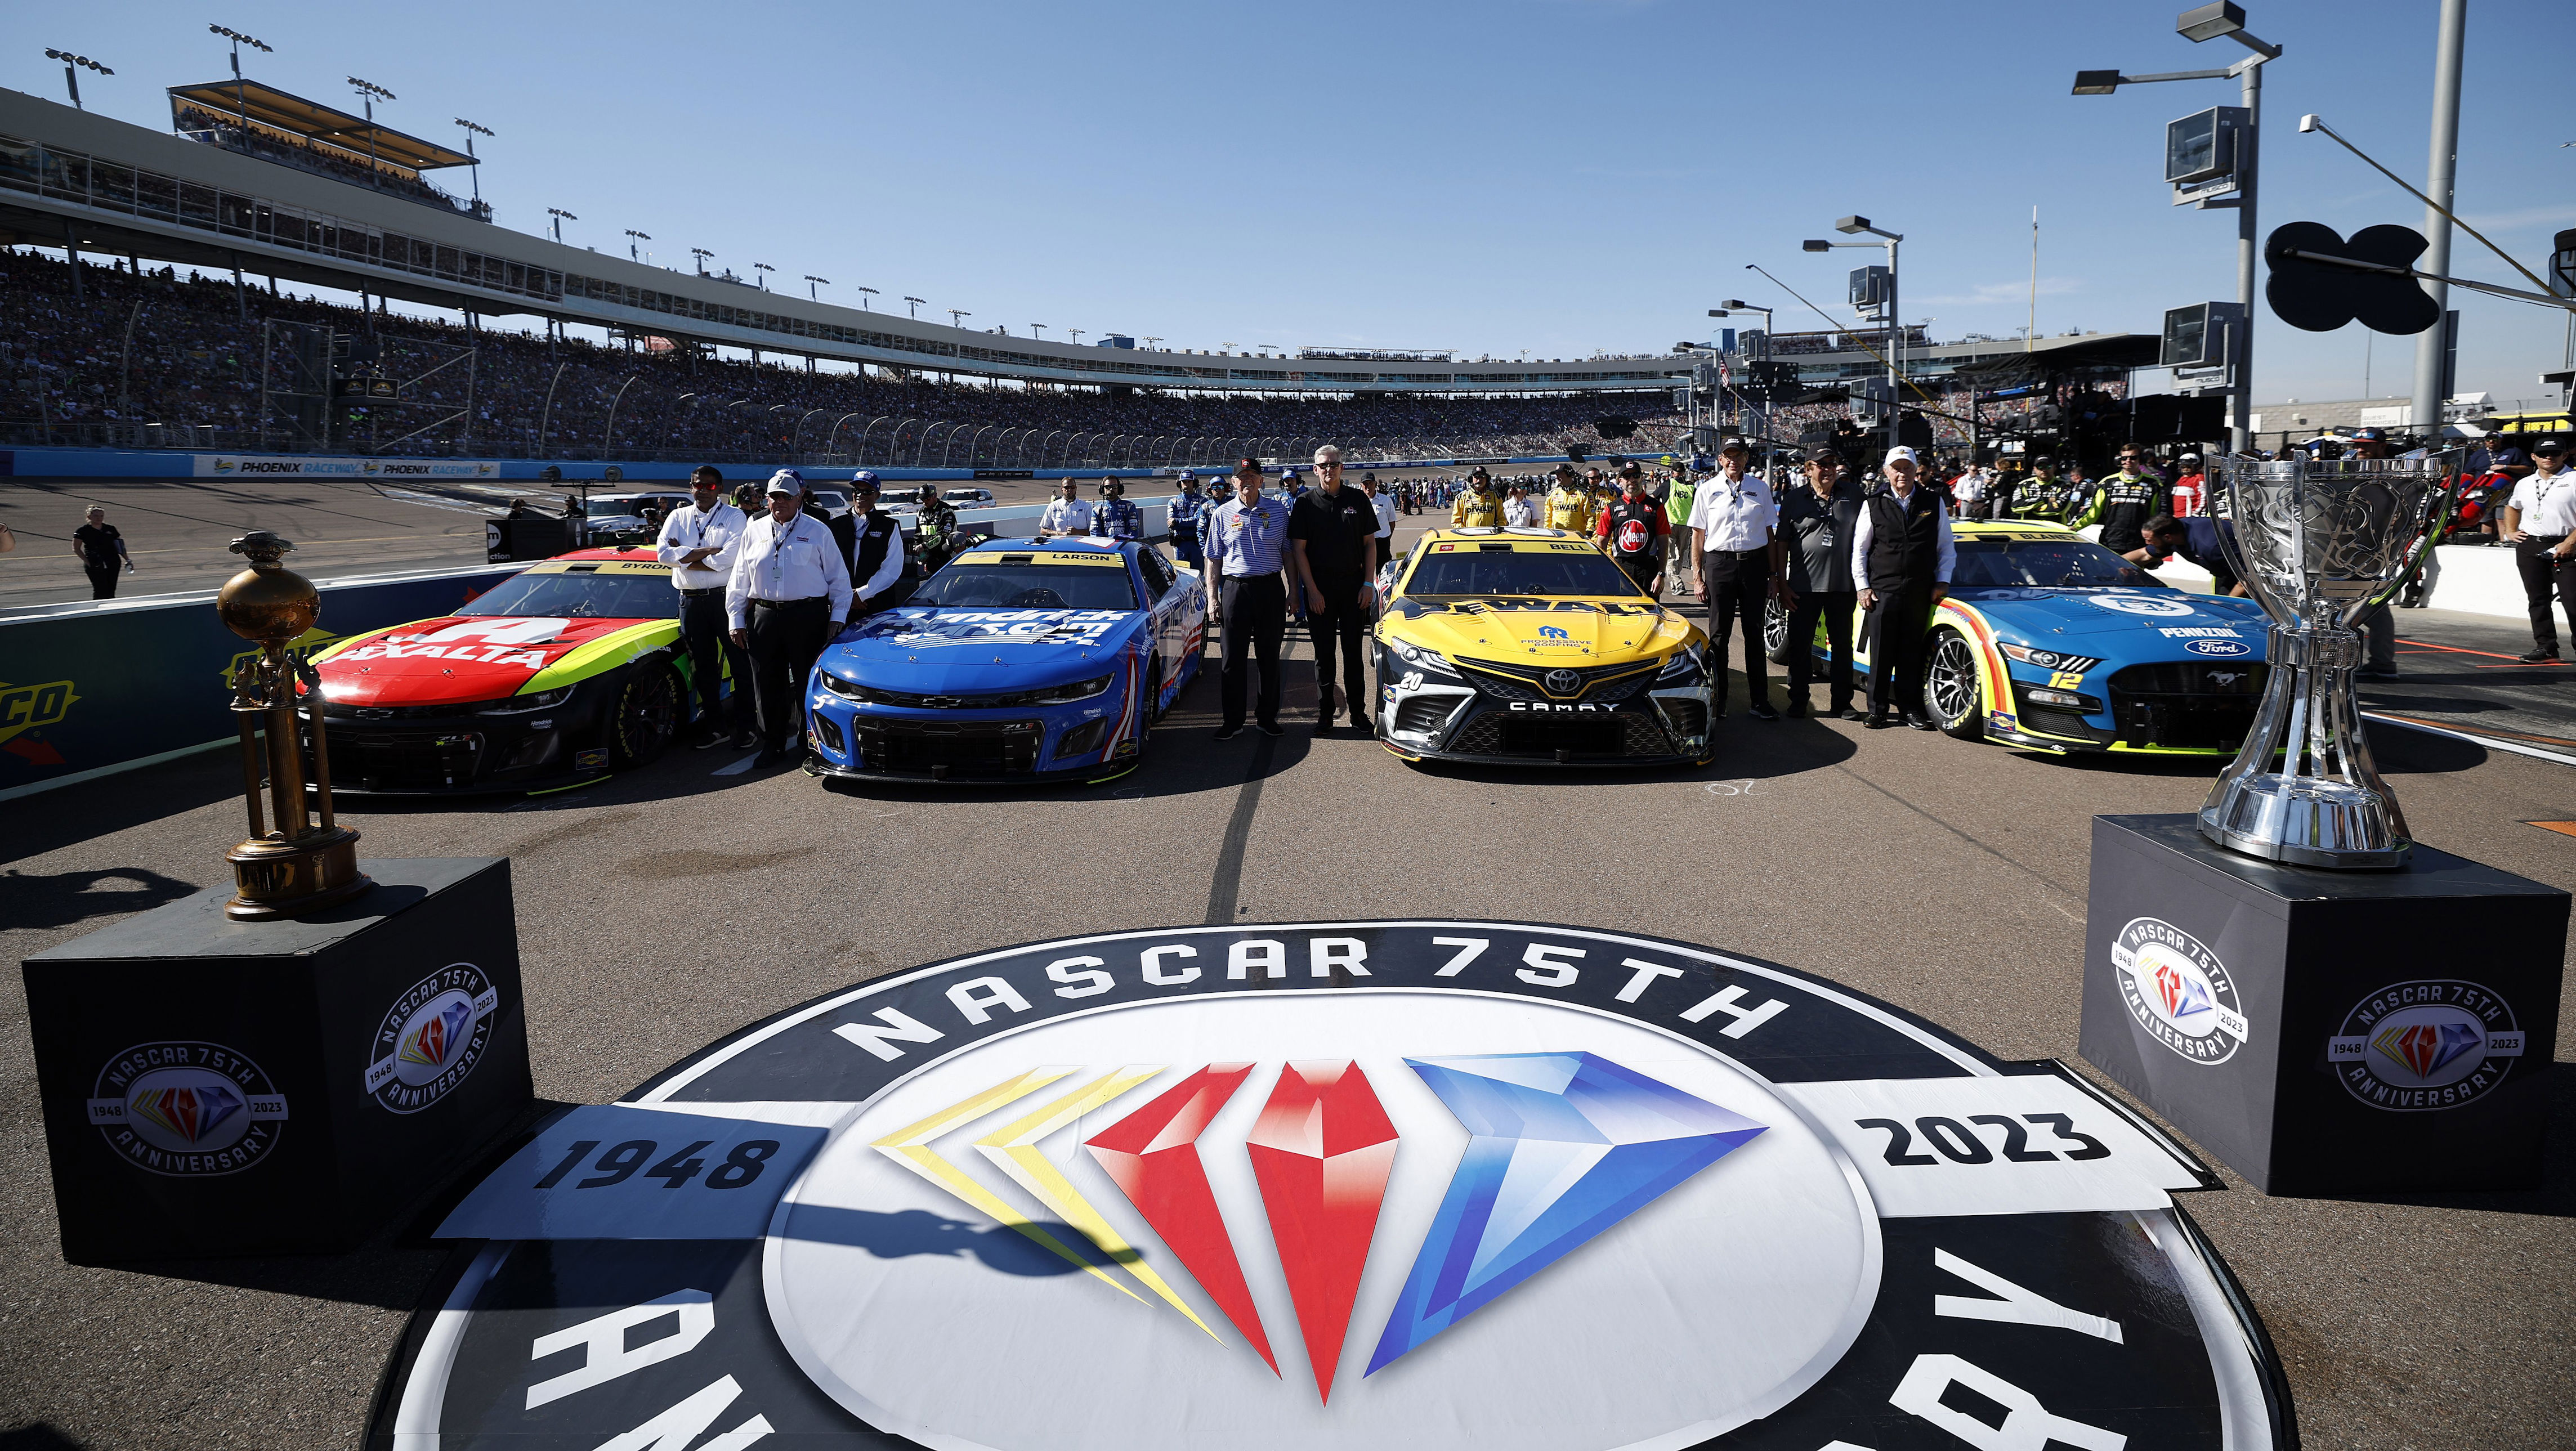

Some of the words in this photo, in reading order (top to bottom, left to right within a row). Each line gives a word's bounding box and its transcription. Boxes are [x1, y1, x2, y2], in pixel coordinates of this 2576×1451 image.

[240, 462, 302, 473] PHOENIX
[303, 463, 358, 473] RACEWAY
[384, 465, 431, 474] PHOENIX
[432, 465, 473, 474] RACEWAY
[1675, 490, 1689, 499] NBC
[1621, 527, 1646, 547] Rheem
[2158, 628, 2243, 638] PENNZOIL
[2199, 642, 2239, 653] Ford
[1399, 671, 1424, 691] 20
[2047, 671, 2083, 690] 12
[1991, 716, 2015, 727] SUNOCO
[1116, 744, 1136, 753] SUNOCO
[578, 755, 606, 764] SUNOCO
[2115, 950, 2132, 967] 1948
[2129, 924, 2185, 951] NASCAR
[2190, 943, 2229, 993] 75TH
[382, 978, 439, 1044] NASCAR
[444, 970, 478, 991] 75TH
[477, 994, 494, 1011] 2023
[832, 936, 1372, 1063] NASCAR
[1430, 936, 1790, 1041] 75TH
[2358, 986, 2442, 1025] NASCAR
[2450, 986, 2501, 1022] 75TH
[2124, 980, 2227, 1057] ANNIVERSARY
[2221, 1013, 2243, 1033] 2023
[2334, 1044, 2362, 1054] 1948
[2491, 1038, 2519, 1049] 2023
[109, 1047, 190, 1087] NASCAR
[198, 1047, 255, 1085] 75TH
[369, 1063, 392, 1084] 1948
[387, 1023, 487, 1107] ANNIVERSARY
[2349, 1062, 2498, 1106] ANNIVERSARY
[92, 1105, 122, 1117] 1948
[253, 1101, 283, 1113] 2023
[117, 1125, 269, 1171] ANNIVERSARY
[1853, 1112, 2112, 1167] 2023
[533, 1140, 780, 1190] 1948
